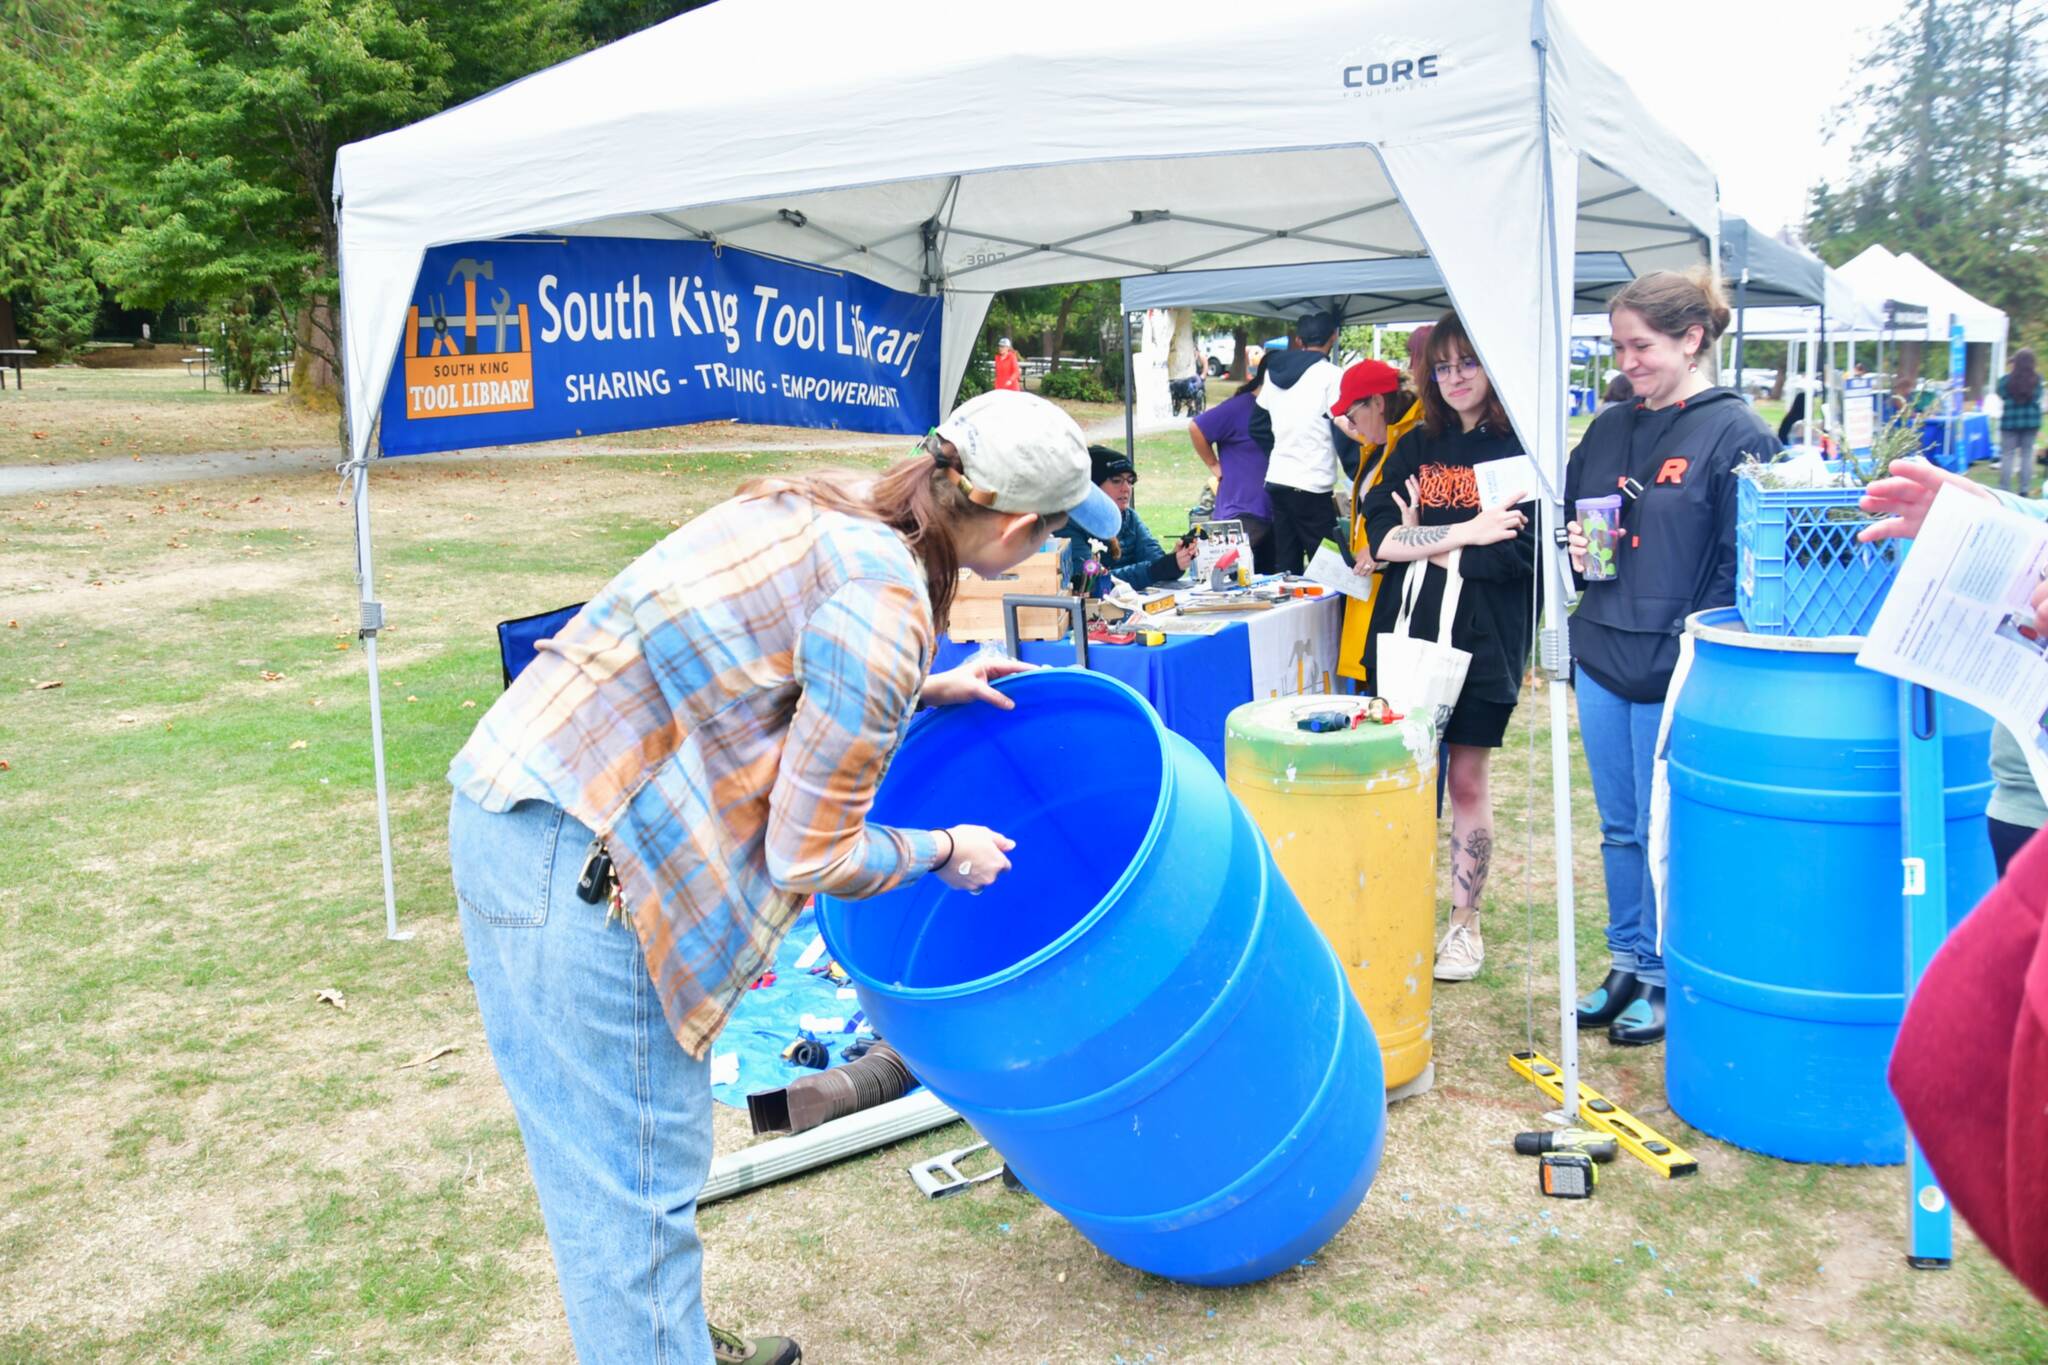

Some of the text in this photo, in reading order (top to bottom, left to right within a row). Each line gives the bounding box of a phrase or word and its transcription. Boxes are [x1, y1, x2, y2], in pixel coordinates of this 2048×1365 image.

[1343, 54, 1438, 88] CORE
[538, 274, 655, 343] South
[753, 285, 825, 352] Tool
[434, 361, 509, 377] SOUTH KING
[410, 379, 529, 411] TOOL LIBRARY
[565, 368, 671, 403] SHARING
[782, 374, 900, 409] EMPOWERMENT
[1655, 457, 1689, 485] R
